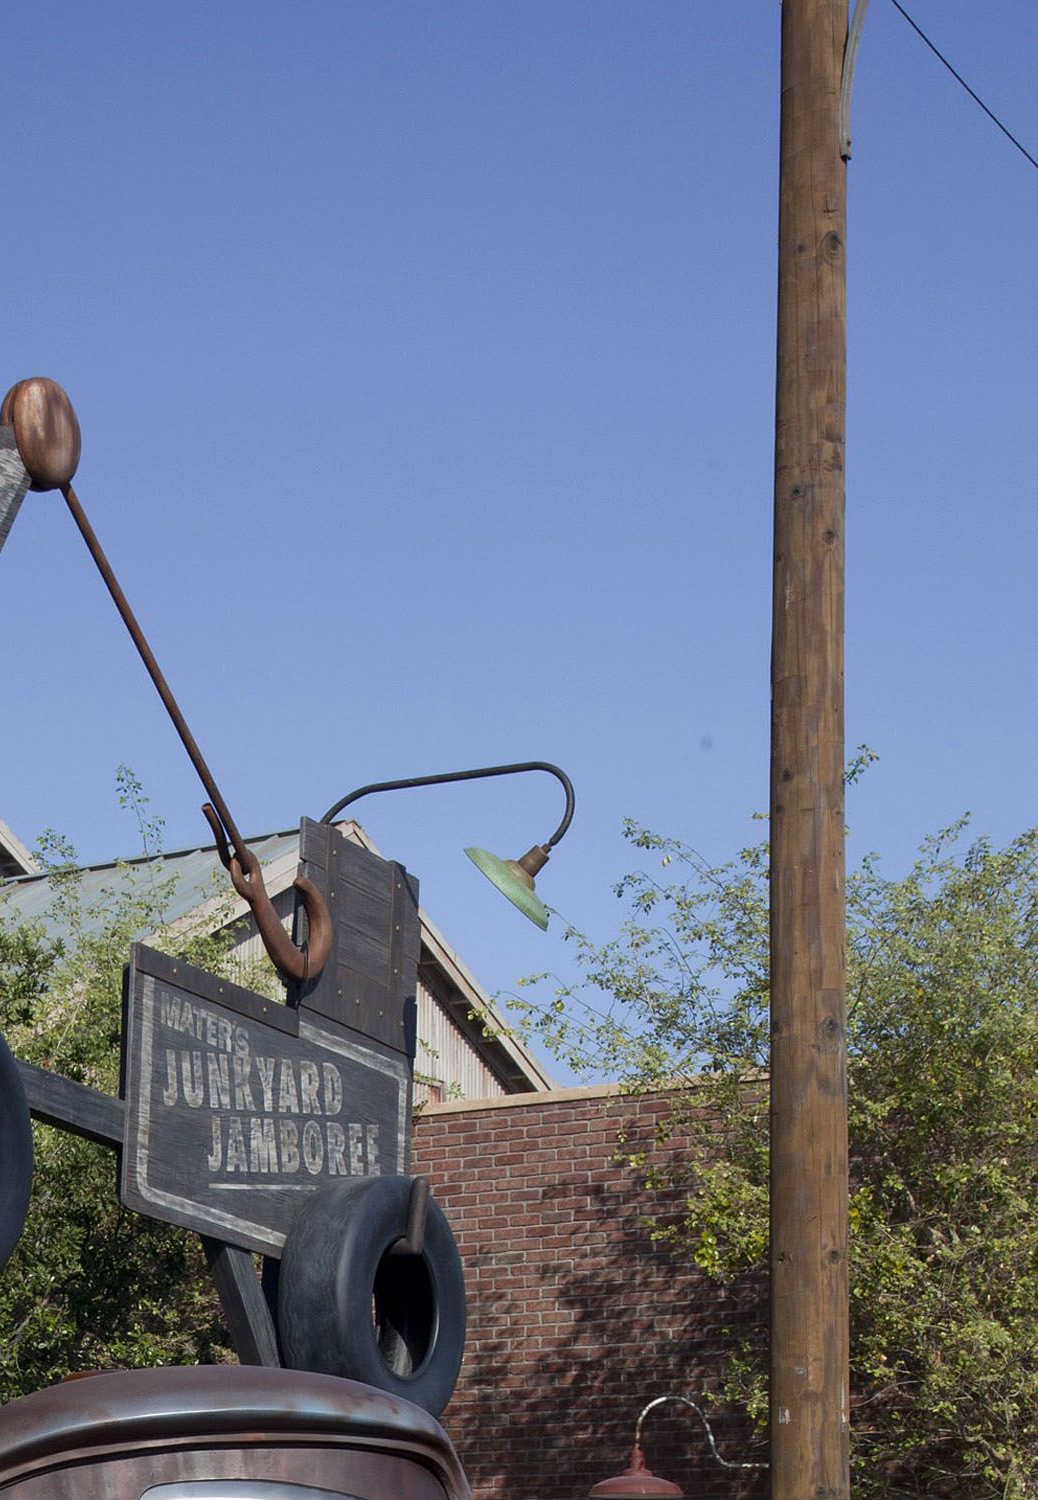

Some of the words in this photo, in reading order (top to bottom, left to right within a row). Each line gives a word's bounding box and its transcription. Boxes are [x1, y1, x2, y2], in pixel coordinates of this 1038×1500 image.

[160, 991, 249, 1056] MATER'S
[163, 1049, 343, 1115] JUNKYARD
[208, 1116, 381, 1176] JAMBOREE
